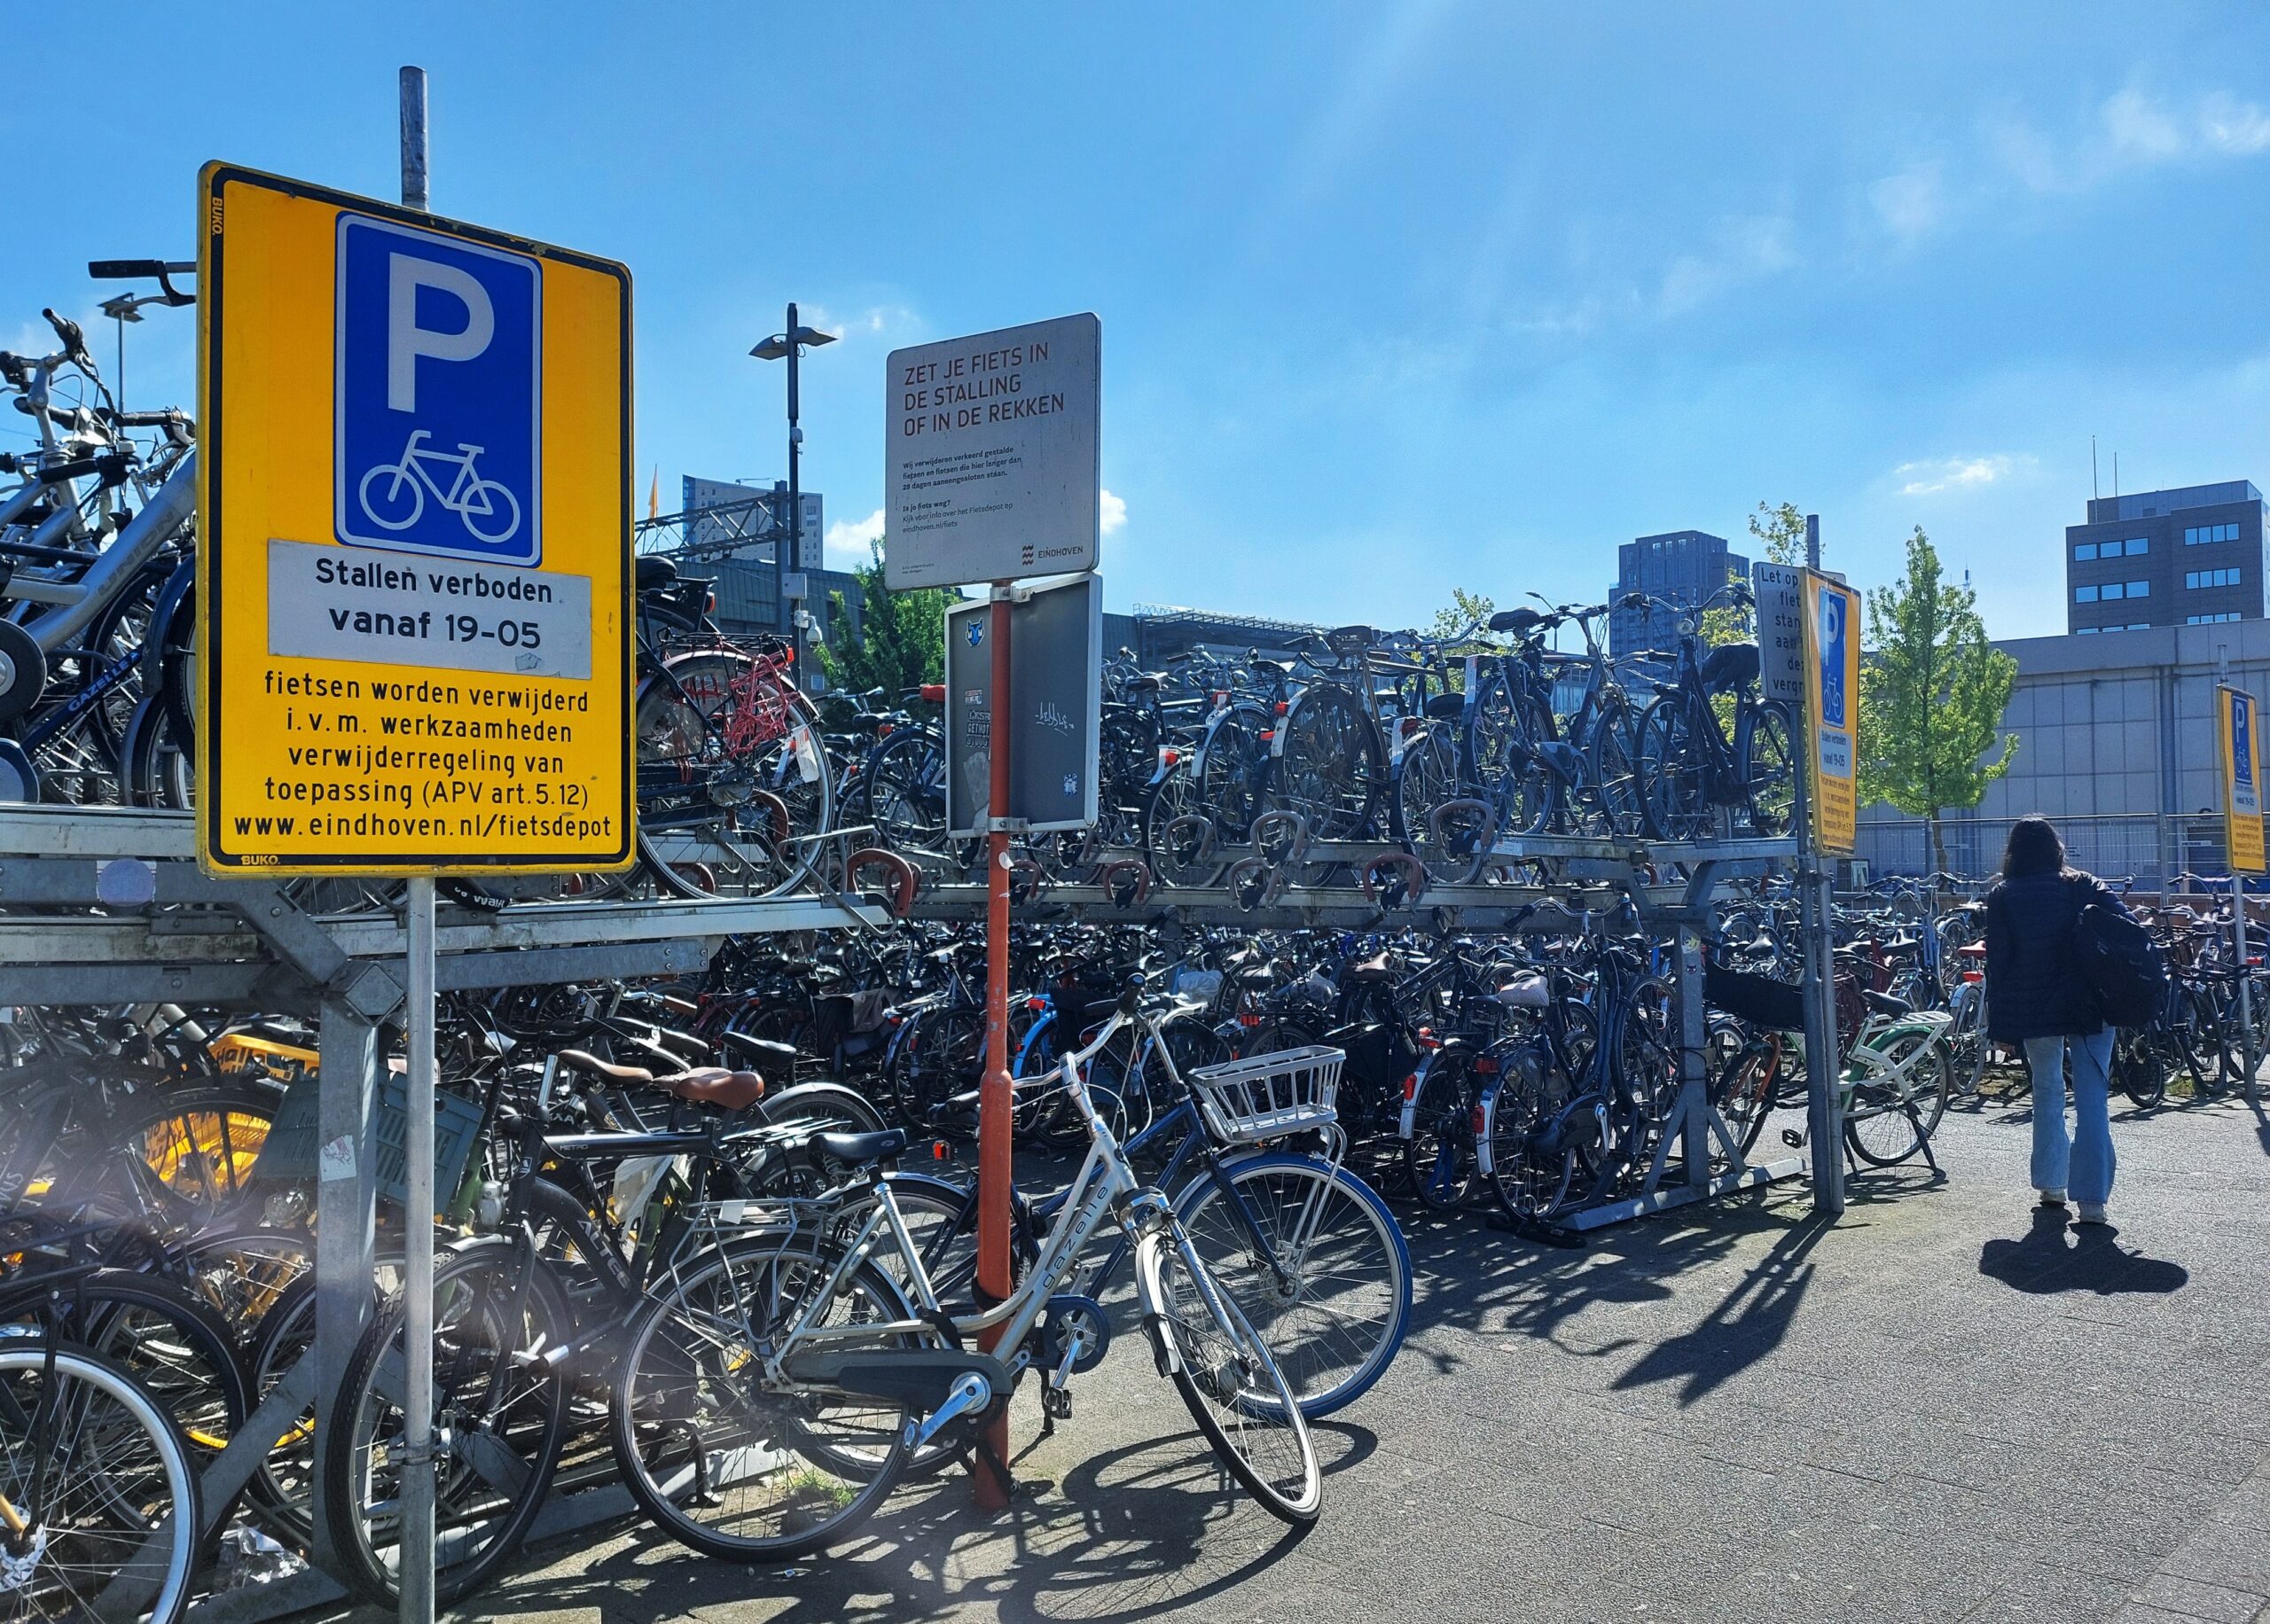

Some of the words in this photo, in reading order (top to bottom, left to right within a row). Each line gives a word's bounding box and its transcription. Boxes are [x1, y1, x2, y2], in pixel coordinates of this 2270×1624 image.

[388, 252, 495, 413] P
[904, 363, 937, 386] ZET
[943, 358, 965, 379] JE
[972, 347, 1022, 374] FIETS
[1029, 341, 1048, 363] IN
[904, 390, 928, 411] DE
[934, 373, 1022, 407] STALLING
[904, 416, 927, 437] OF
[933, 412, 951, 433] IN
[958, 406, 982, 429] DE
[989, 392, 1065, 423] REKKEN
[903, 461, 913, 470] Wij
[915, 457, 952, 467] verwijderen
[954, 449, 983, 461] verkeerd
[984, 446, 1014, 458] gestalde
[903, 471, 925, 481] fietsen
[935, 466, 958, 475] fietsen
[971, 461, 984, 470] hier
[986, 458, 1007, 468] langer
[912, 480, 932, 489] dagen
[933, 473, 985, 486] aaneengesloten
[986, 470, 1008, 479] staan.
[910, 504, 917, 513] je
[934, 499, 951, 509] weg?
[969, 503, 1004, 513] Fietsdepot
[1005, 503, 1014, 511] op
[97, 511, 176, 597] UNION
[1037, 545, 1084, 558] EINDHOVEN
[316, 558, 418, 592] Stallen
[429, 571, 552, 604] verboden
[1761, 567, 1781, 584] Let
[328, 607, 431, 639] vanaf
[445, 613, 541, 649] 19-05
[1825, 595, 1839, 667] P
[67, 660, 132, 712] GAZELLE
[265, 670, 360, 699] fietsen
[371, 680, 458, 705] worden
[468, 687, 589, 716] verwijderd
[380, 714, 573, 743] werkzaamheden
[2235, 701, 2245, 743] P
[287, 746, 515, 778] verwijderregeling
[523, 754, 564, 774] van
[265, 777, 412, 808] toepassing
[422, 780, 483, 809] (APV
[234, 812, 611, 841] www.eindhoven.nl/fietsdepot
[1043, 1185, 1108, 1290] gazelle
